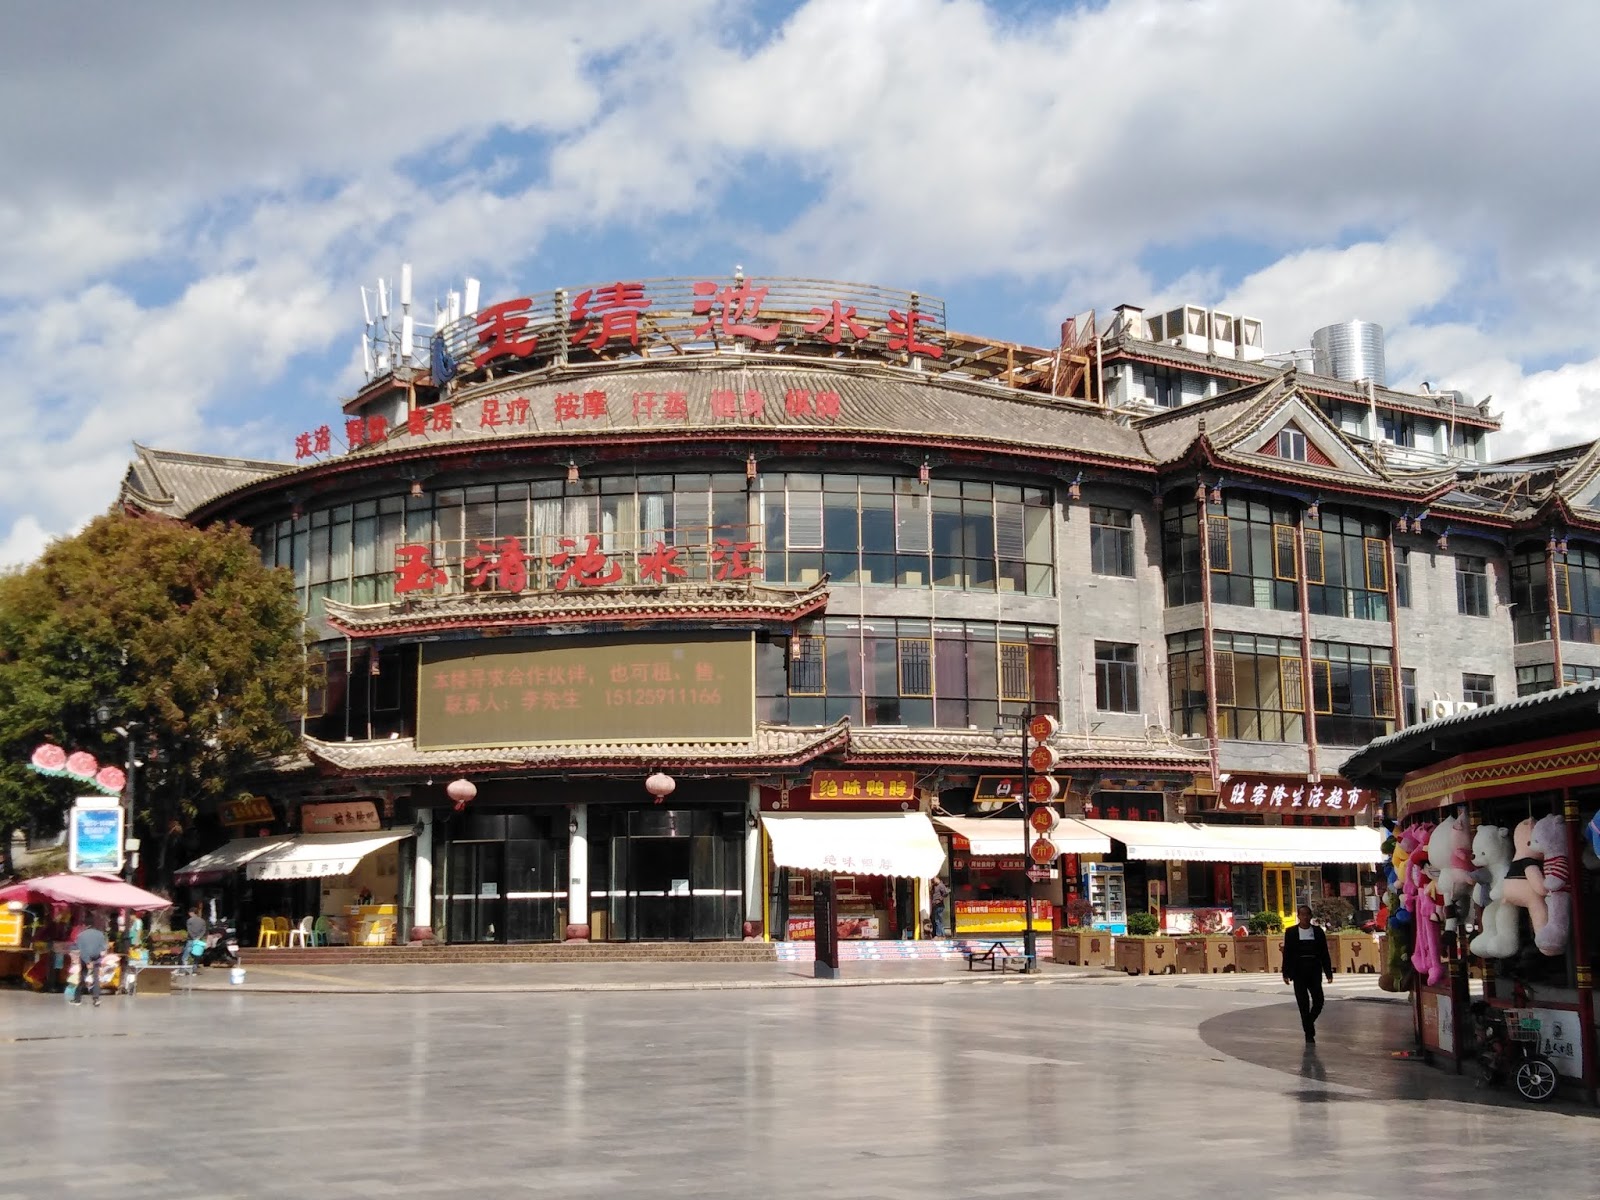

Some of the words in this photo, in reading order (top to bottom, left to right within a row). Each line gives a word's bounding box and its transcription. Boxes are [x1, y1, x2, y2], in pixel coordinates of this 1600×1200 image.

[474, 277, 944, 368] 玉清池水汇
[407, 403, 453, 436] 客房
[480, 396, 530, 427] 足疗
[554, 390, 607, 422] 按摩
[632, 391, 688, 419] 汗蒸
[394, 534, 763, 593] 玉清池水汇
[819, 779, 907, 797] 绝味鸭脖
[1230, 781, 1362, 809] 旺客隆生活超市
